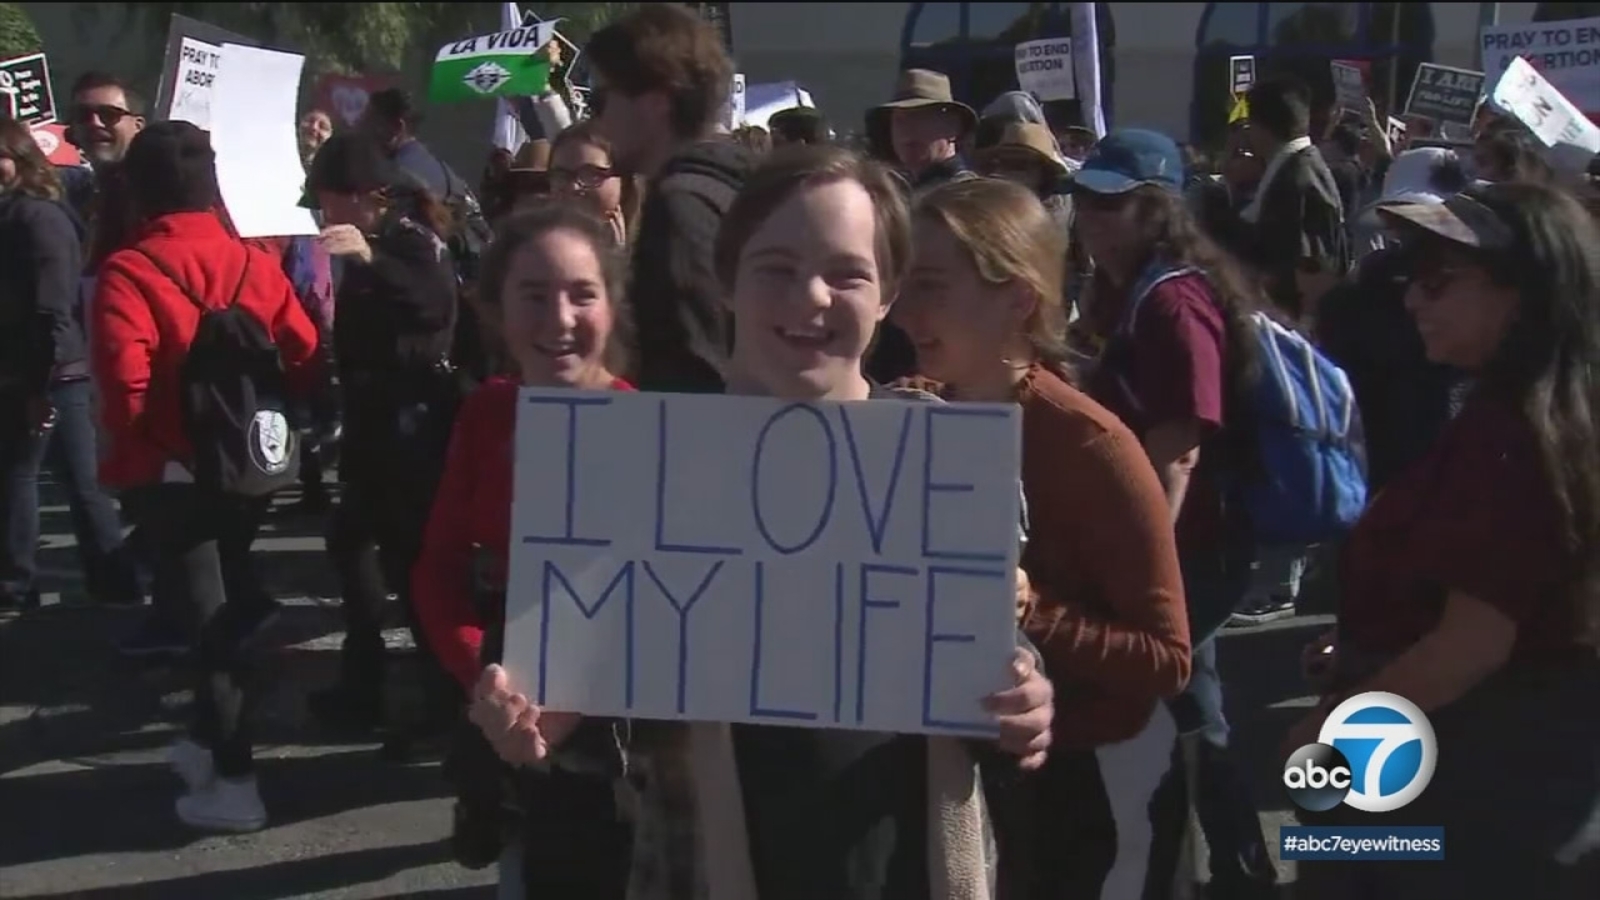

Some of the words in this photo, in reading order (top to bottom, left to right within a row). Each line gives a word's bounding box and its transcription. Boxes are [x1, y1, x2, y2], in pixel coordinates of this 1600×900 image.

[449, 39, 476, 55] LA
[487, 25, 539, 49] VIDA
[1029, 45, 1042, 57] TO
[1044, 43, 1069, 56] END
[1484, 30, 1537, 50] PRAY
[1543, 29, 1571, 46] TO
[183, 45, 208, 65] PRAY
[523, 396, 612, 546] I
[654, 399, 1011, 561] LOVE
[538, 560, 724, 714] MY
[750, 561, 1005, 734] LIFE
